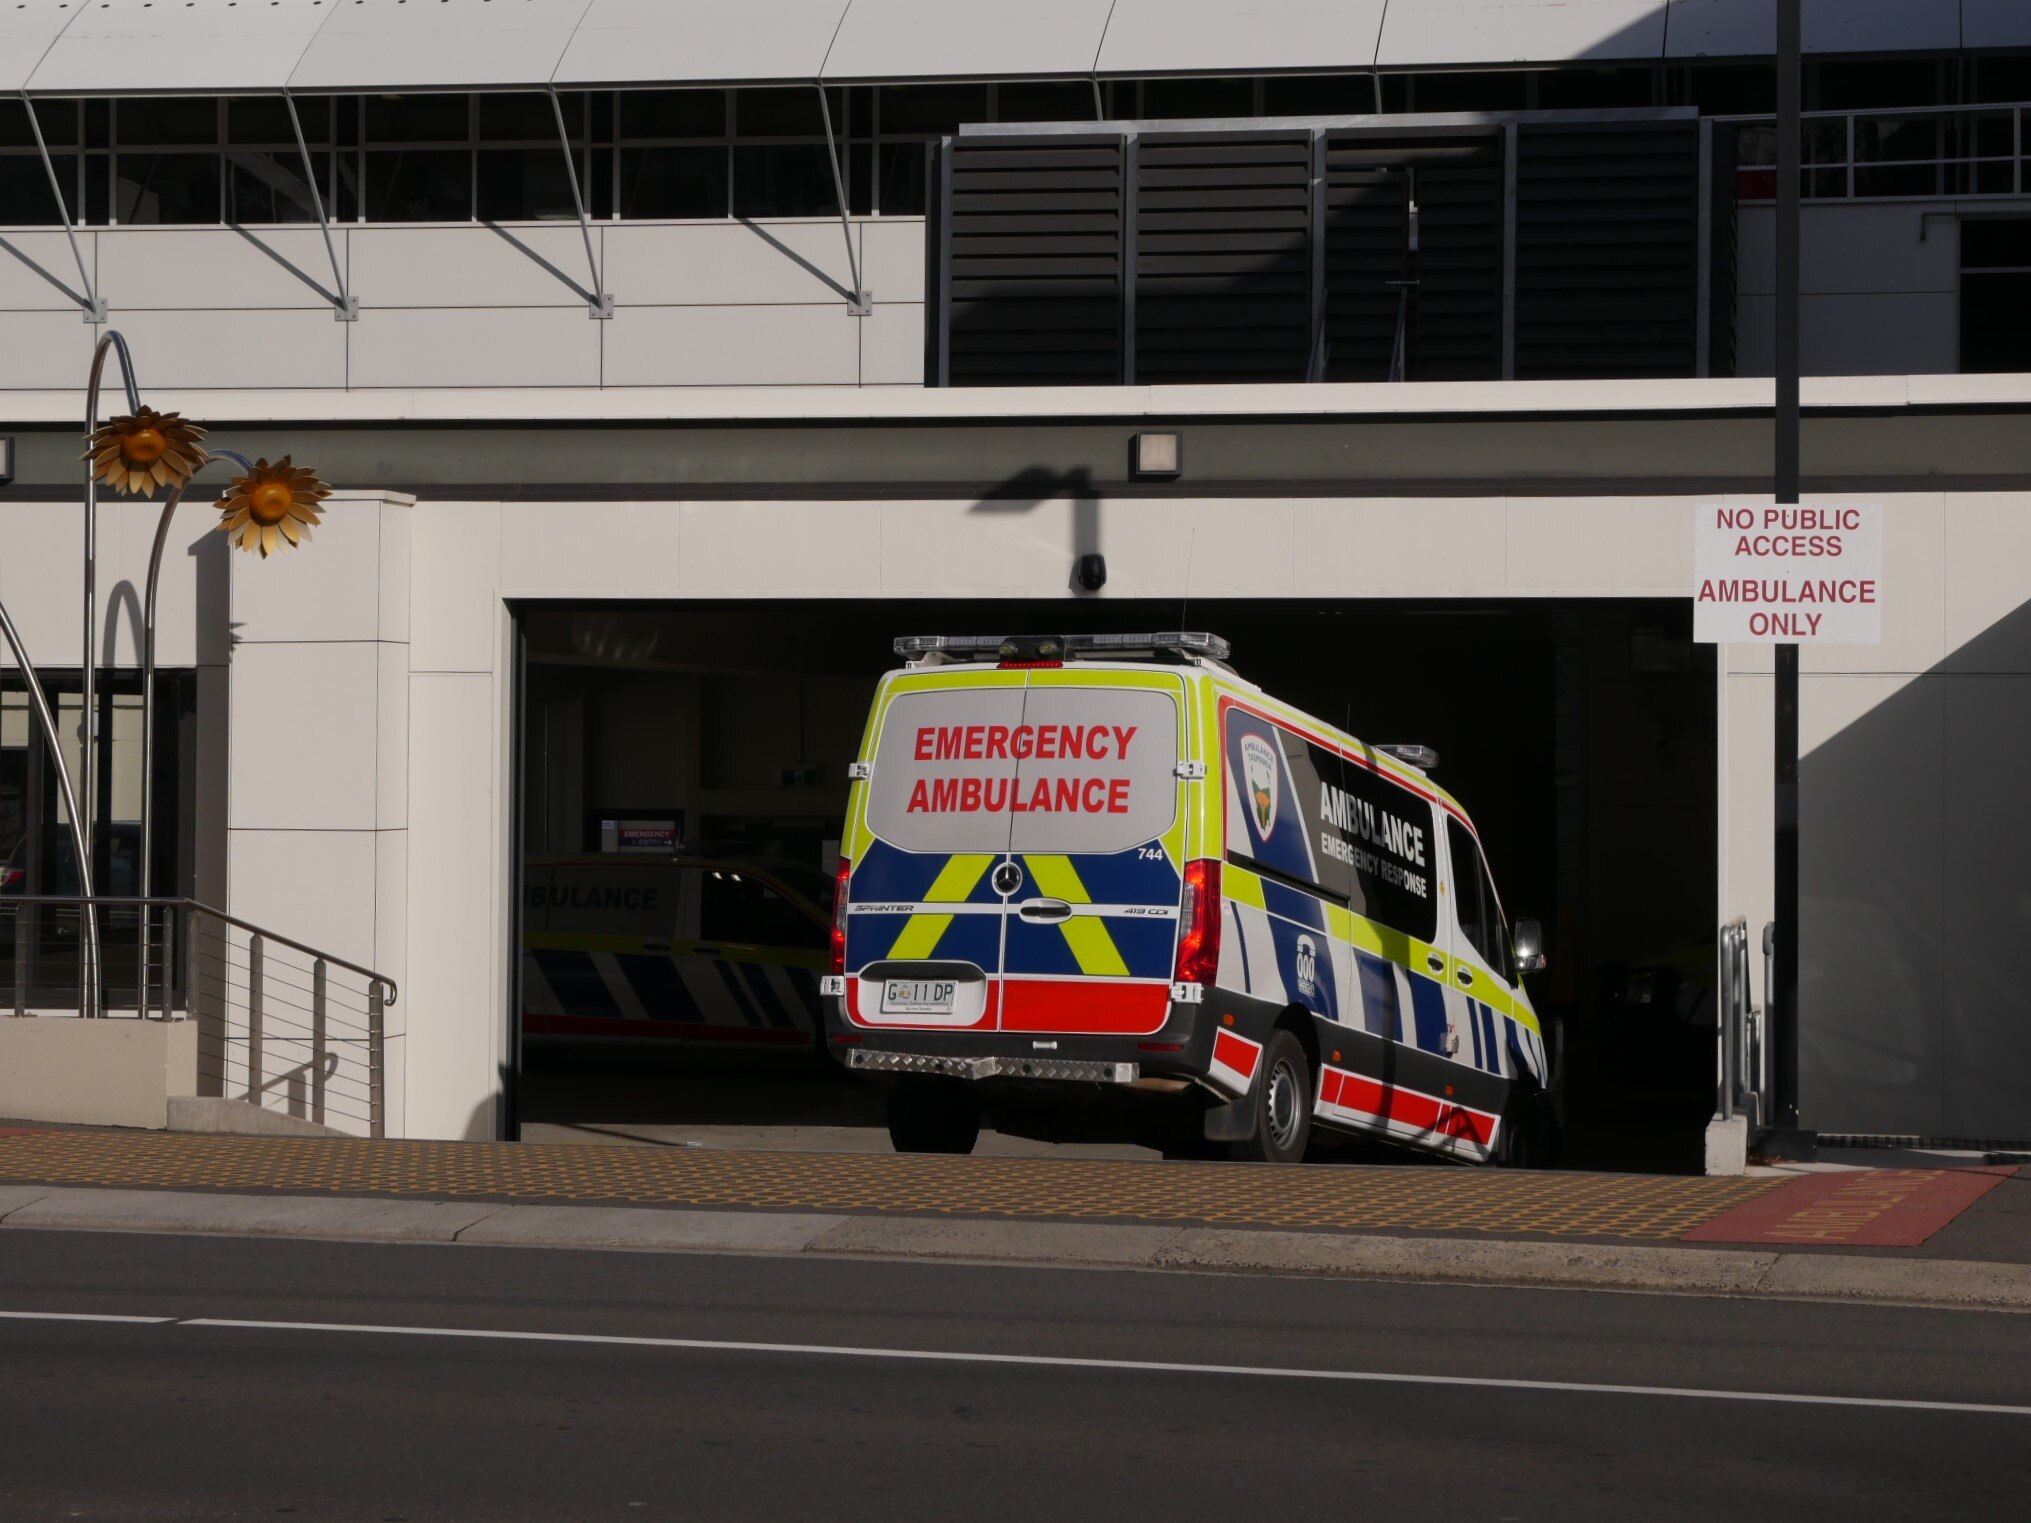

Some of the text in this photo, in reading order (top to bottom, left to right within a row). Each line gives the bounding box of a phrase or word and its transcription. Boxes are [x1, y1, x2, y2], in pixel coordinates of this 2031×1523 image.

[1717, 509, 1860, 530] NO PUBLIC
[1734, 535, 1843, 557] ACCESS
[1698, 579, 1876, 604] AMBULANCE
[1749, 612, 1823, 636] ONLY
[914, 725, 1138, 761] EMERGENCY
[1244, 742, 1274, 765] AMBULANCE
[1247, 753, 1273, 771] TASMANIA
[906, 778, 1130, 813] AMBULANCE
[624, 830, 670, 838] EMERGENCY
[1320, 782, 1426, 867] AMBULANCE
[1138, 848, 1163, 861] 744
[1321, 832, 1427, 899] EMERGENCY RESPONSE
[523, 886, 658, 911] BULANCE
[1296, 952, 1315, 983] 000
[888, 983, 954, 1002] G 11 DP
